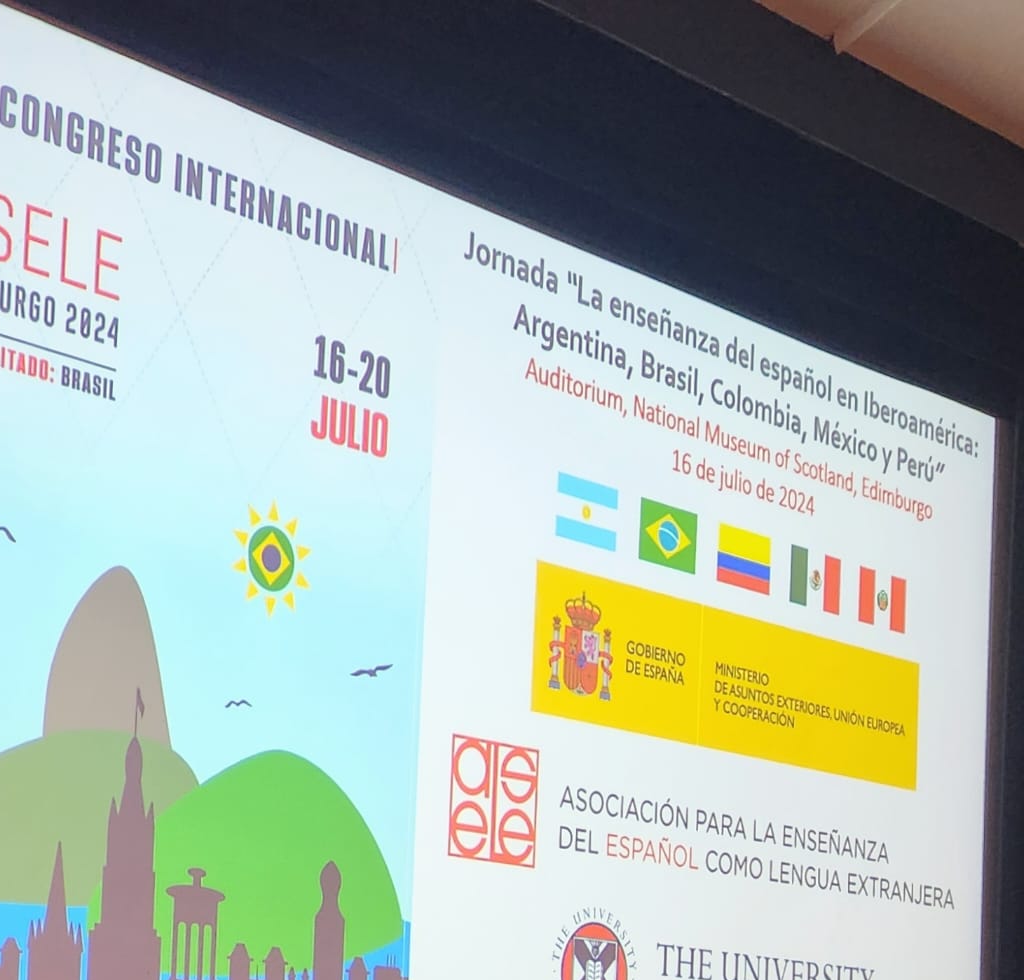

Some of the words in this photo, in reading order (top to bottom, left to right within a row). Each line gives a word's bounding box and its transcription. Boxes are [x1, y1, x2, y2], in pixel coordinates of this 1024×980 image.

[0, 85, 162, 184] CONGRESO
[174, 153, 390, 272] INTERNACIONAL
[65, 302, 119, 348] 2024
[464, 231, 559, 294] Jornada
[609, 294, 720, 358] enseñanza
[725, 335, 755, 370] del
[760, 356, 832, 404] español
[837, 386, 859, 411] en
[864, 391, 979, 458] Iberoamérica:
[61, 365, 116, 401] BRASIL
[313, 335, 391, 399] 16-20
[513, 303, 633, 380] Argentina,
[641, 350, 703, 406] Brasil,
[710, 378, 807, 443] Colombia,
[814, 416, 877, 462] México
[881, 446, 893, 474] y
[311, 395, 389, 458] JULIO
[524, 358, 627, 418] Auditorium,
[633, 395, 700, 438] National
[705, 420, 771, 464] Museum
[775, 440, 790, 469] of
[793, 451, 857, 498] Scotland,
[862, 477, 933, 522] Edimburgo
[672, 449, 692, 475] 16
[696, 454, 716, 482] de
[719, 462, 752, 497] julio
[756, 475, 775, 501] de
[779, 485, 815, 517] 2024
[626, 641, 686, 667] GOBIERNO
[626, 659, 640, 676] DE
[644, 664, 685, 686] ESPAÑA
[715, 662, 769, 686] MINISTERIO
[713, 698, 721, 712] Y
[723, 701, 795, 729] COOPERACIÓN
[714, 680, 728, 696] DE
[729, 684, 774, 706] ASUNTOS
[776, 695, 832, 720] EXTERIORES,
[833, 709, 865, 728] UNIÓN
[866, 716, 906, 737] EUROPEA
[559, 785, 689, 831] ASOCIACIÓN
[695, 809, 746, 840] PARA
[752, 819, 776, 845] LA
[782, 825, 889, 865] ENSEÑANZA
[558, 825, 599, 855] DEL
[606, 833, 699, 871] ESPAÑOL
[705, 849, 763, 881] COMO
[769, 860, 842, 892] LENGUA
[847, 873, 955, 910] EXTRANJERA
[656, 942, 713, 980] THE
